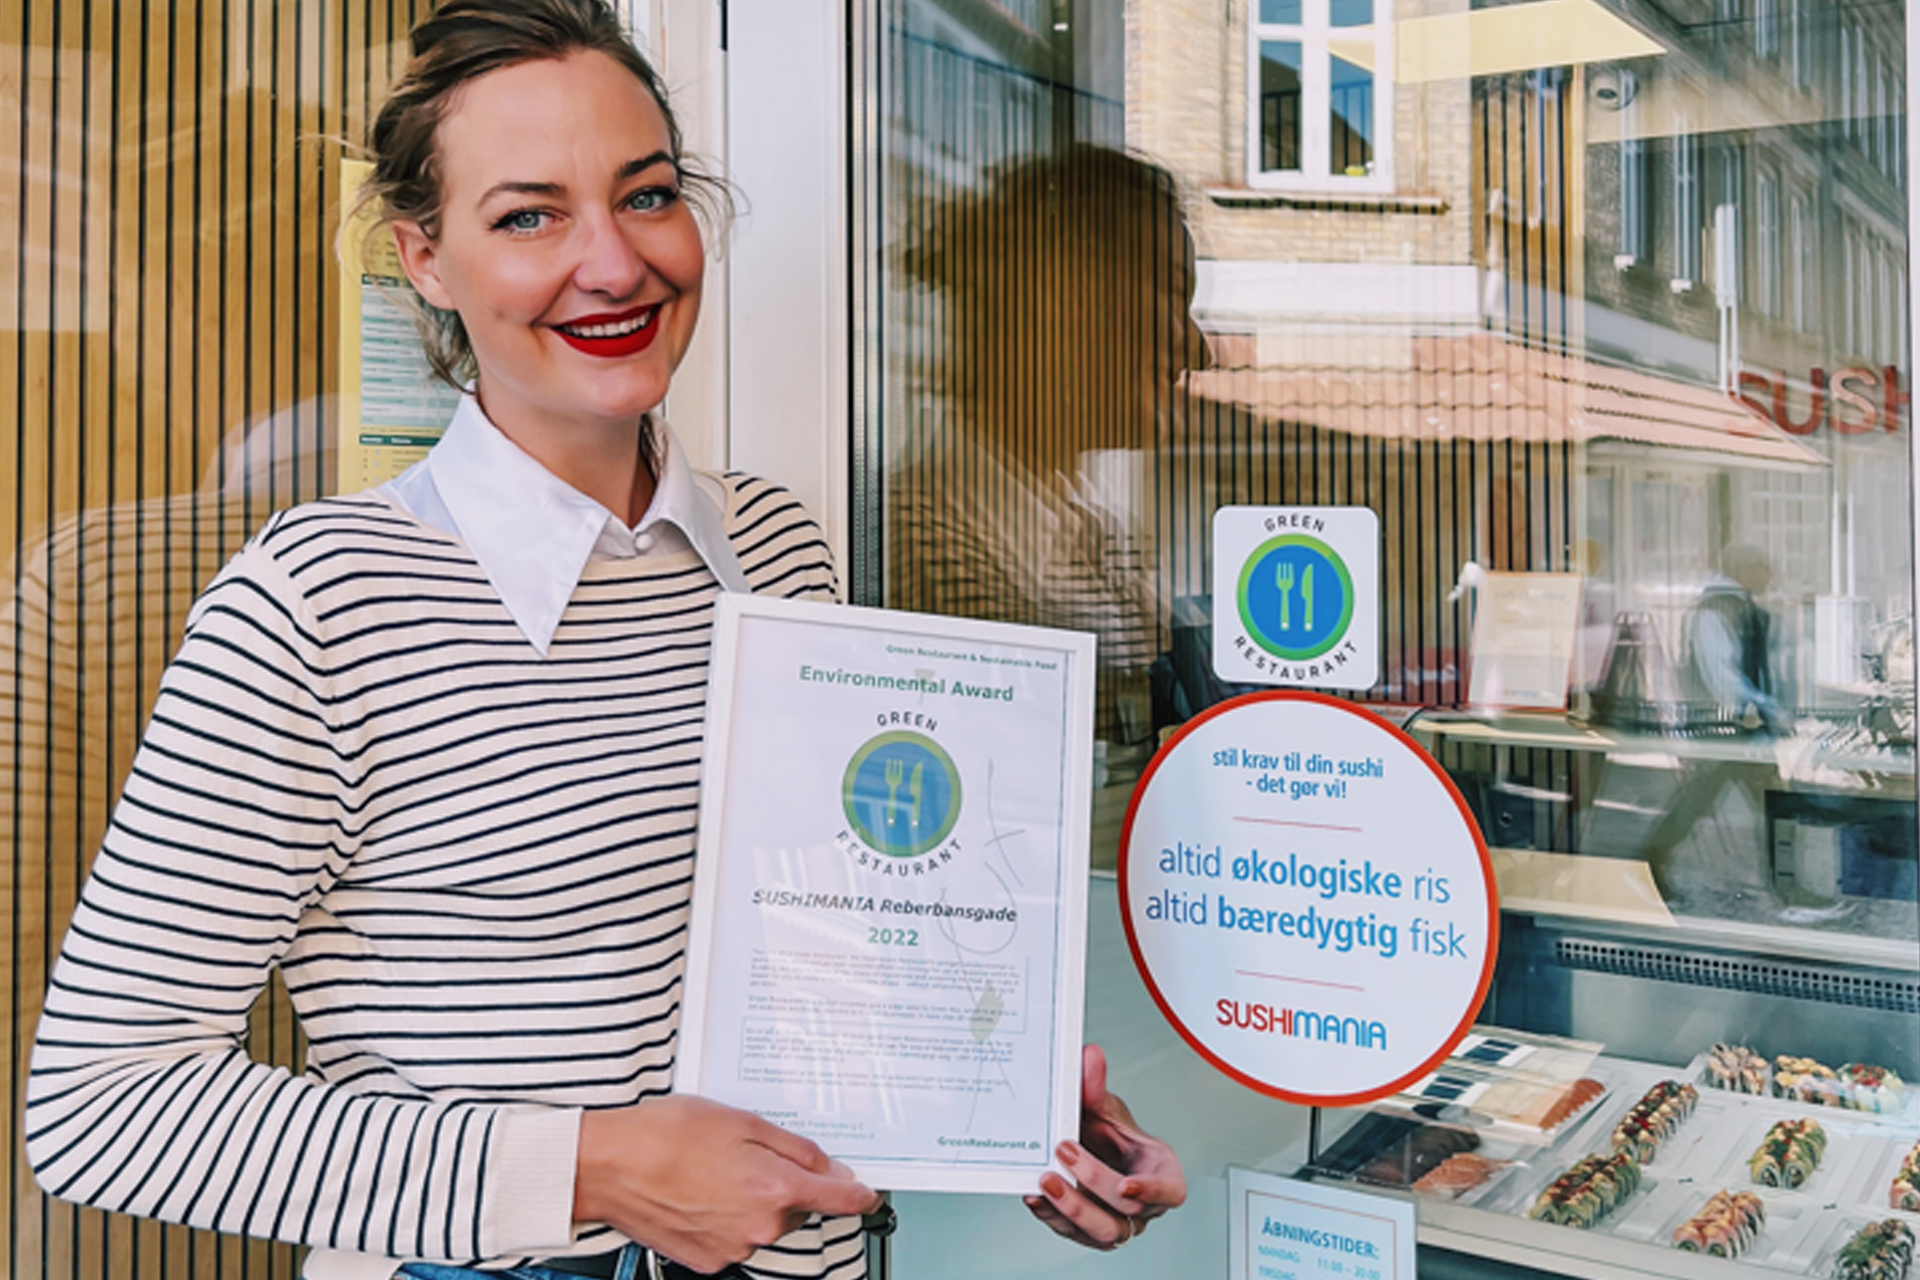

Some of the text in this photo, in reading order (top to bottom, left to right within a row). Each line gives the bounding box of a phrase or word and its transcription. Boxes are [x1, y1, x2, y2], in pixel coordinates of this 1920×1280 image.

[1264, 513, 1326, 533] GREEN
[1234, 635, 1358, 682] RESTAURANT
[799, 665, 1014, 702] Environmental Award
[876, 711, 938, 732] GREEN
[1213, 748, 1384, 779] stil krav til din sushi
[1257, 774, 1286, 794] det
[1290, 779, 1319, 801] gør
[1324, 780, 1347, 799] vi!
[836, 829, 964, 878] RESTAURANT
[1159, 841, 1450, 904] altid økologiske ris
[752, 889, 1018, 923] SUSHIMANIA Reberbansgade
[1145, 889, 1467, 959] altid bæredygtig fisk
[867, 926, 919, 947] 2022
[1215, 998, 1387, 1051] SUSHIMANIA
[1261, 1216, 1380, 1260] ÅBNINGSTIDER:
